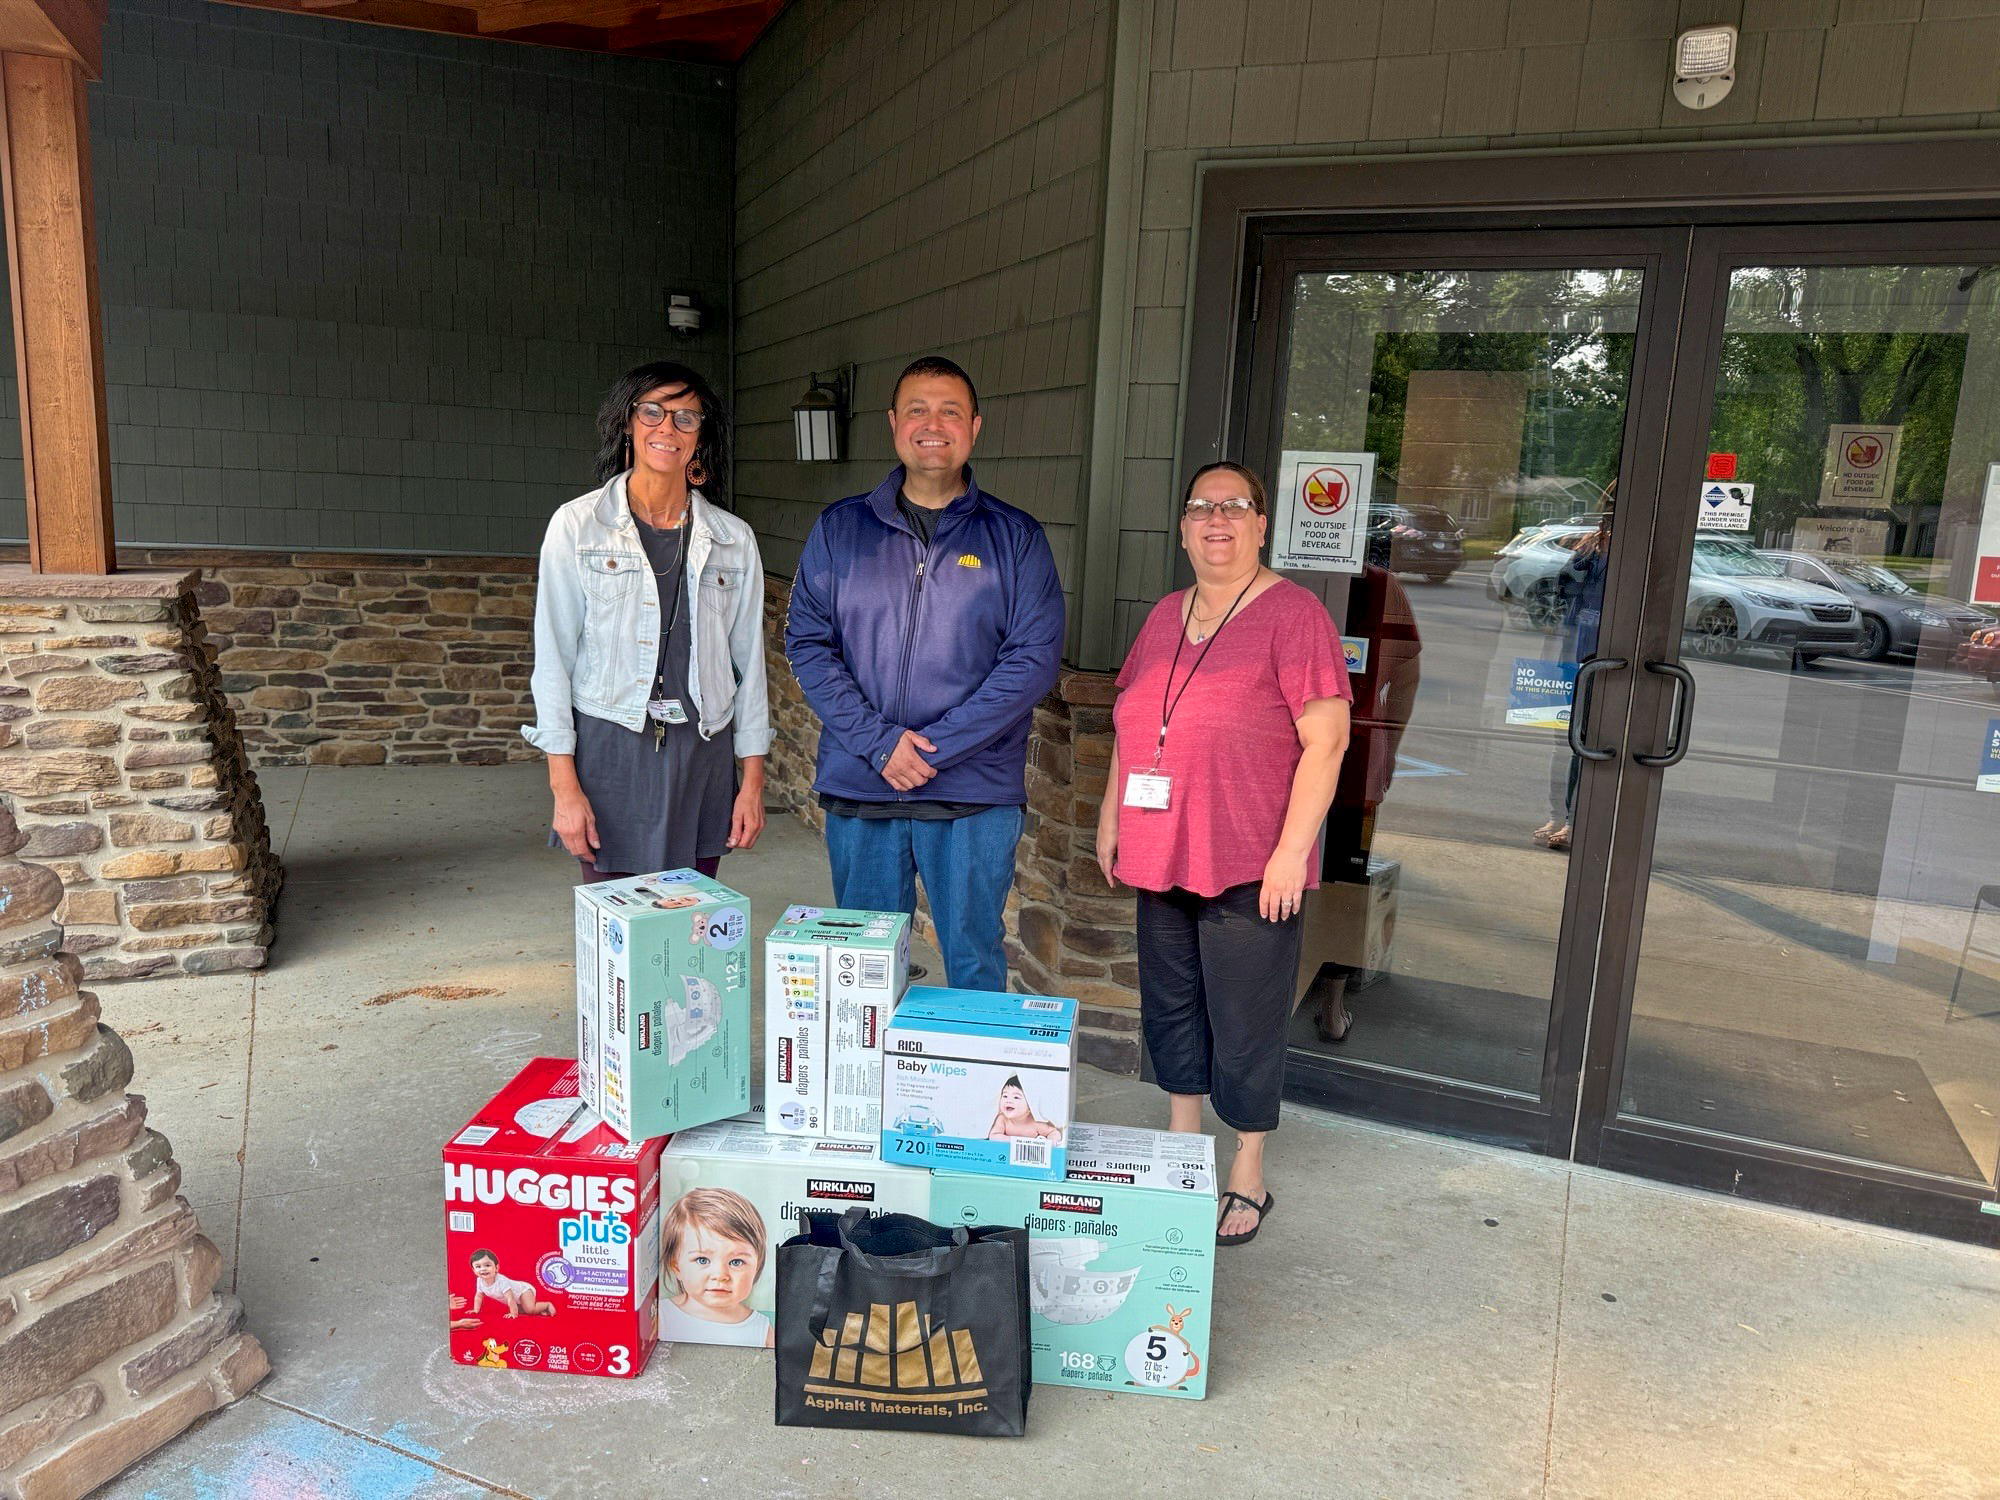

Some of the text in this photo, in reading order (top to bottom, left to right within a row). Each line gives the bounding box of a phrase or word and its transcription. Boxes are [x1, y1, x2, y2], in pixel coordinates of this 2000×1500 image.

[1300, 521, 1347, 530] NO OUTSIDE
[1816, 524, 1855, 533] Welcome
[1305, 531, 1340, 540] FOOD OR
[1301, 541, 1342, 550] BEVERAGE
[1517, 667, 1536, 677] NO
[1516, 677, 1574, 690] SMOKING
[1541, 688, 1572, 696] FACILITY
[709, 922, 728, 938] 2
[615, 931, 623, 945] 2
[725, 963, 739, 993] 112
[607, 958, 616, 1041] diapers pañales
[652, 1000, 662, 1056] diapers pañales
[863, 1006, 871, 1047] KIRKLAND
[1029, 1029, 1059, 1038] RICO
[897, 1039, 923, 1053] RICO
[779, 1038, 787, 1081] KIRKLAND
[796, 1026, 810, 1096] diapers pañales
[897, 1060, 967, 1077] Baby Wipes
[809, 1116, 818, 1129] 96
[819, 1142, 871, 1151] KIRKLAND
[895, 1138, 925, 1155] 720
[1106, 1161, 1151, 1173] diapers
[1181, 1162, 1205, 1171] 168
[1068, 1173, 1131, 1184] KIRKLAND
[1181, 1179, 1196, 1190] 5
[443, 1162, 636, 1213] HUGGIES
[810, 1180, 873, 1194] KIRKLAND
[810, 1190, 872, 1200] Signature
[1043, 1193, 1101, 1208] KIRKLAND
[1043, 1203, 1100, 1214] Signature
[562, 1215, 628, 1247] plus
[1024, 1213, 1118, 1237] diapers pañales
[582, 1244, 610, 1256] little
[575, 1255, 617, 1266] movers
[583, 1276, 619, 1284] PROTECTION
[1096, 1282, 1106, 1292] 5
[568, 1294, 603, 1302] PROTECTION
[549, 1345, 567, 1354] 204
[1145, 1335, 1167, 1361] 5
[607, 1344, 631, 1375] 3
[1059, 1350, 1095, 1370] 168
[1144, 1361, 1153, 1371] 27
[1153, 1362, 1163, 1372] lbs
[1060, 1367, 1113, 1382] diapers pañales
[1144, 1371, 1152, 1381] 12
[1152, 1372, 1161, 1383] kg
[804, 1394, 989, 1418] Asphalt Materials, Inc.
